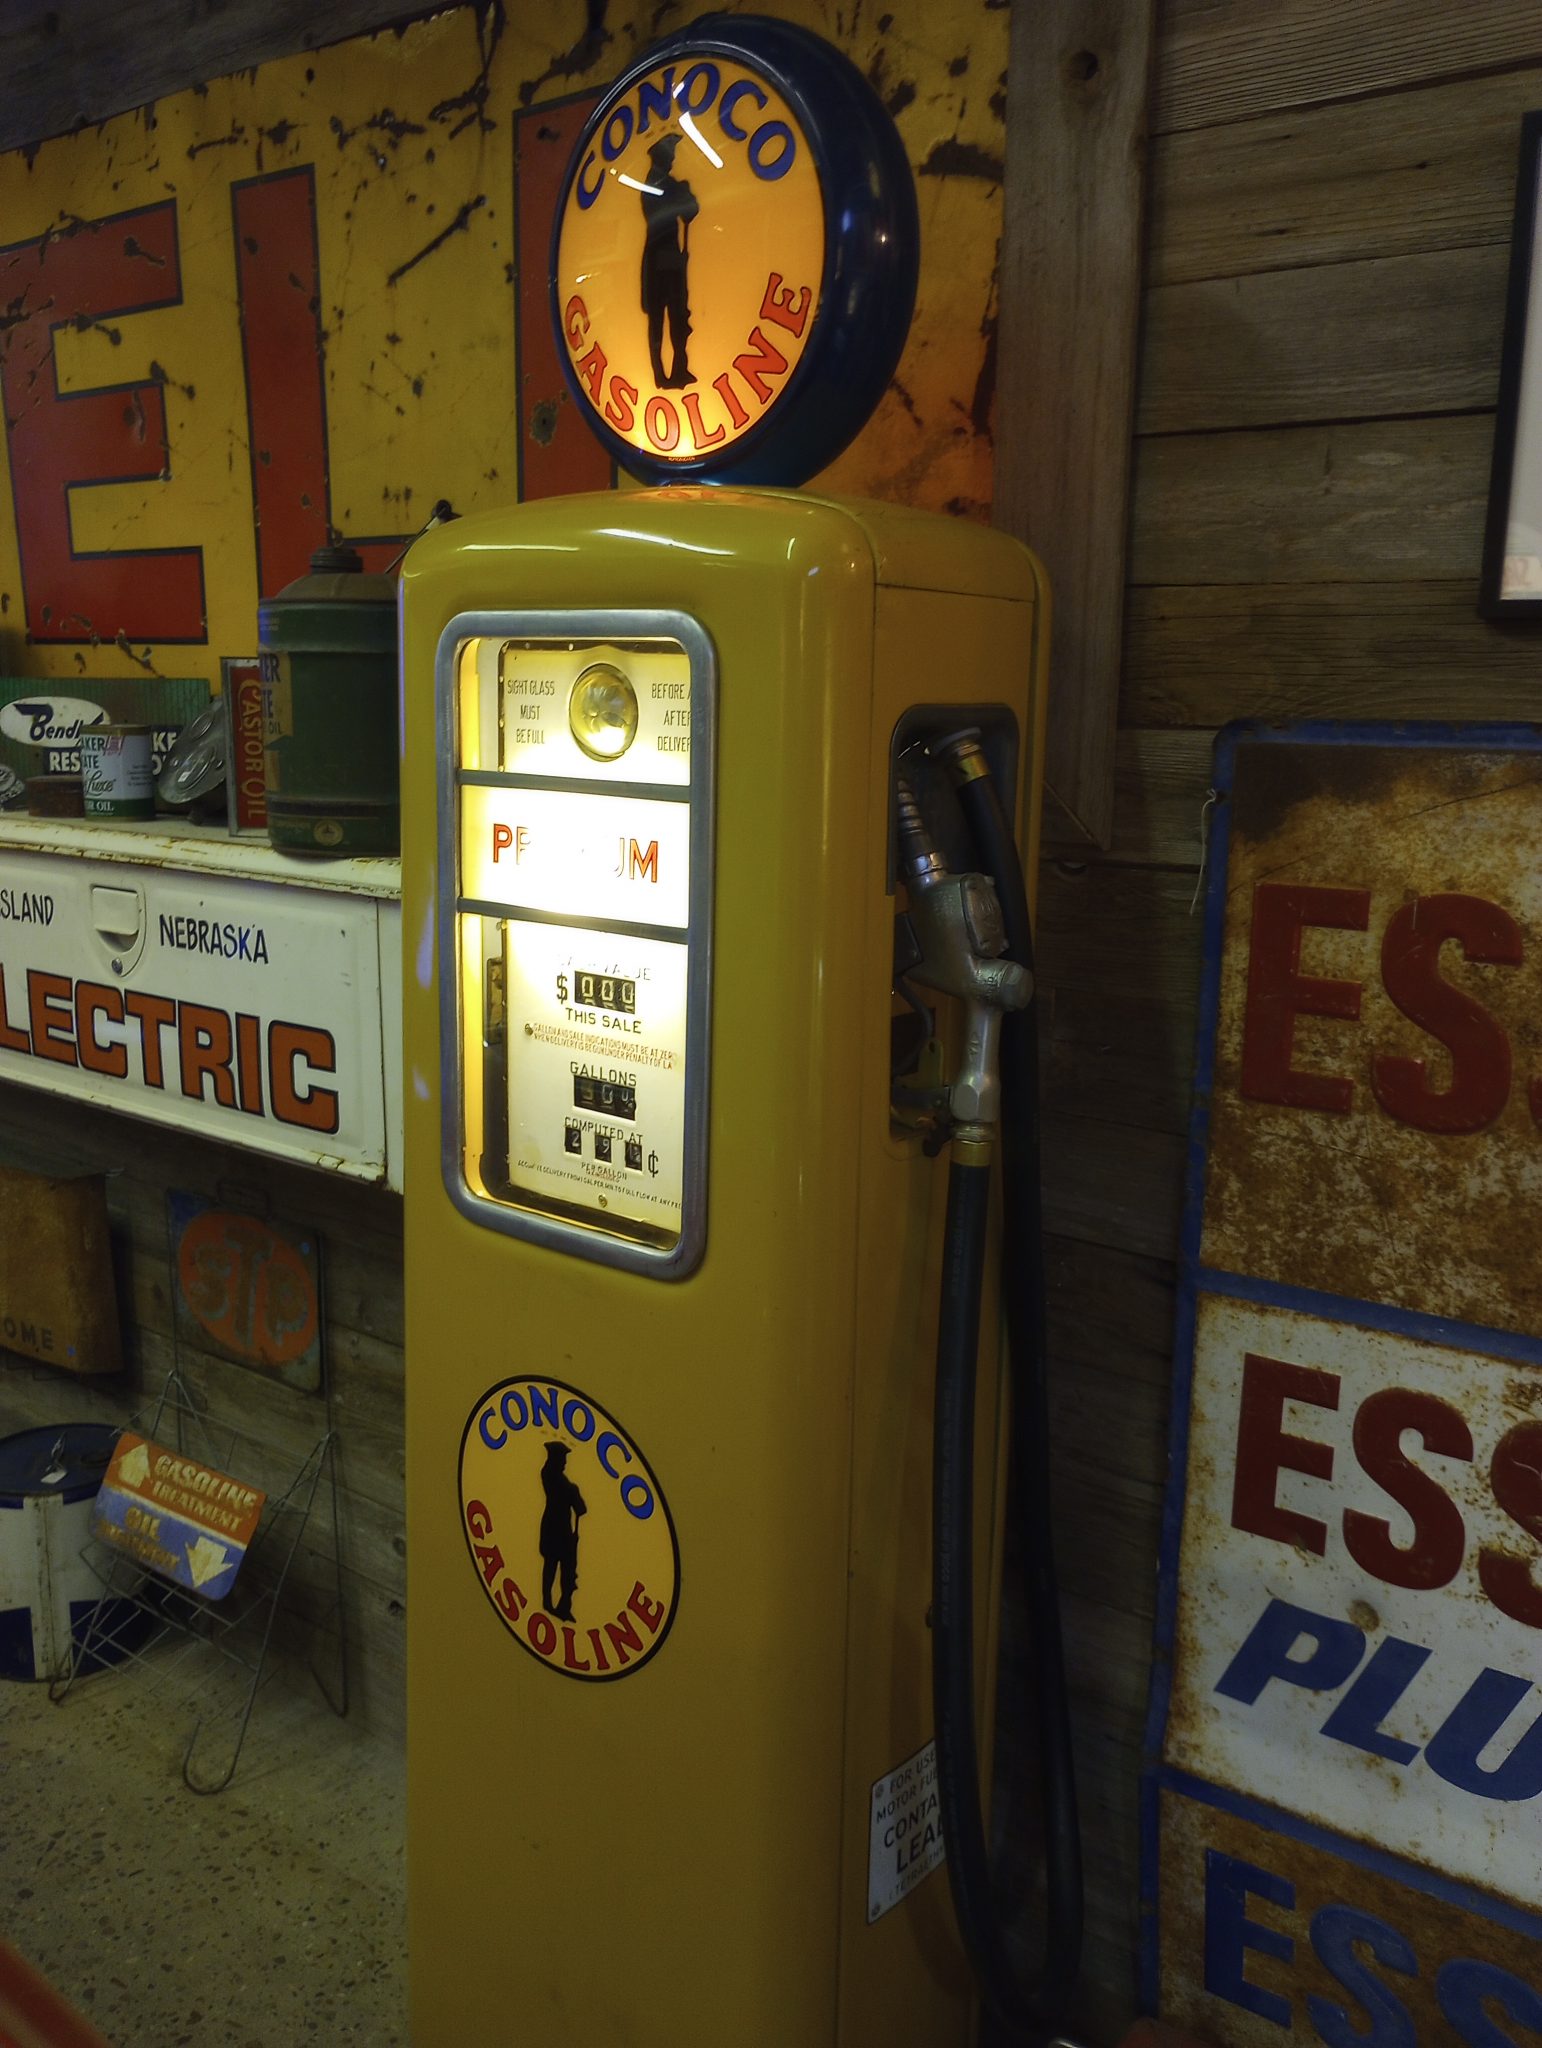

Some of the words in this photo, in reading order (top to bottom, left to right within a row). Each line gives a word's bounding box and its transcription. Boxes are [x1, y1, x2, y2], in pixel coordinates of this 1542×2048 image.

[576, 62, 796, 210] CONOCO
[564, 272, 810, 452] GASOLINE
[507, 680, 528, 694] SIGHT
[529, 681, 555, 696] GLASS
[651, 683, 685, 699] BEFORE
[238, 679, 264, 772] CASTOR
[520, 704, 540, 720] MUST
[516, 729, 526, 744] BE
[527, 730, 545, 745] FULL
[241, 777, 267, 820] OIL
[159, 914, 269, 964] NEBRASKA
[565, 1007, 596, 1025] THIS
[602, 1014, 642, 1034] SALE
[570, 1061, 637, 1088] GALLONS
[565, 1116, 624, 1141] COMPUTED
[629, 1132, 643, 1145] AT
[189, 1221, 311, 1352] STP
[478, 1385, 654, 1520] CONOCO
[153, 1454, 259, 1512] GASOLINE
[466, 1499, 665, 1671] GASOLINE
[890, 1768, 913, 1794] FOR
[876, 1784, 916, 1824] MOTOR
